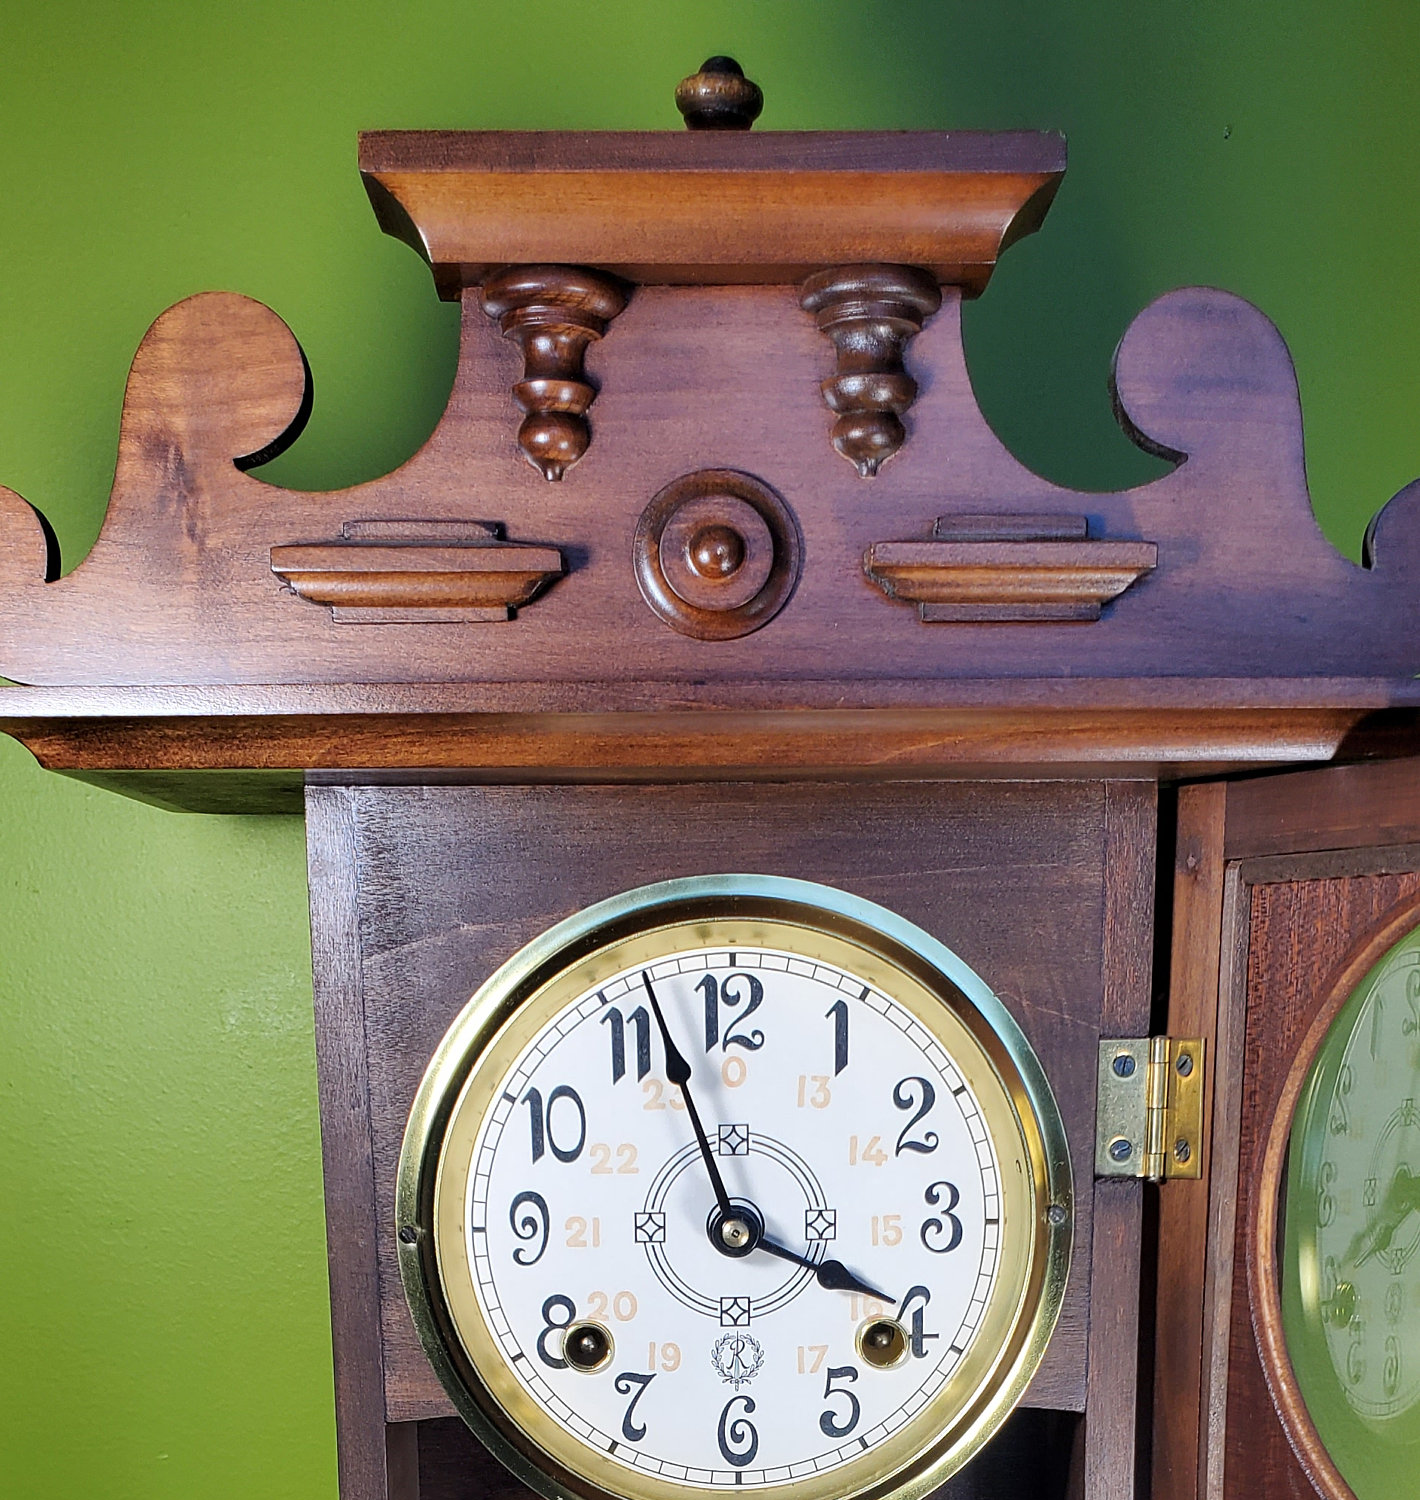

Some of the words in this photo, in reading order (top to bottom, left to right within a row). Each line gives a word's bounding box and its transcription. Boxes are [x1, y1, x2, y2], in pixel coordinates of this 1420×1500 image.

[600, 1005, 651, 1086] 11
[695, 973, 764, 1053] 12
[824, 999, 849, 1077] 1
[721, 1055, 748, 1089] 0
[797, 1075, 831, 1109] 13
[520, 1086, 587, 1165] 10
[849, 1135, 889, 1167] 14
[892, 1076, 940, 1158] 2
[589, 1143, 639, 1174] 22
[509, 1190, 550, 1266] 9
[564, 1216, 601, 1248] 21
[871, 1214, 903, 1247] 15
[920, 1181, 963, 1253] 3
[537, 1294, 577, 1370] 8
[586, 1291, 638, 1322] 20
[896, 1285, 939, 1358] 4
[648, 1341, 682, 1372] 19
[797, 1344, 829, 1374] 17
[614, 1372, 657, 1442] 7
[718, 1395, 759, 1467] 6
[819, 1366, 860, 1438] 5
